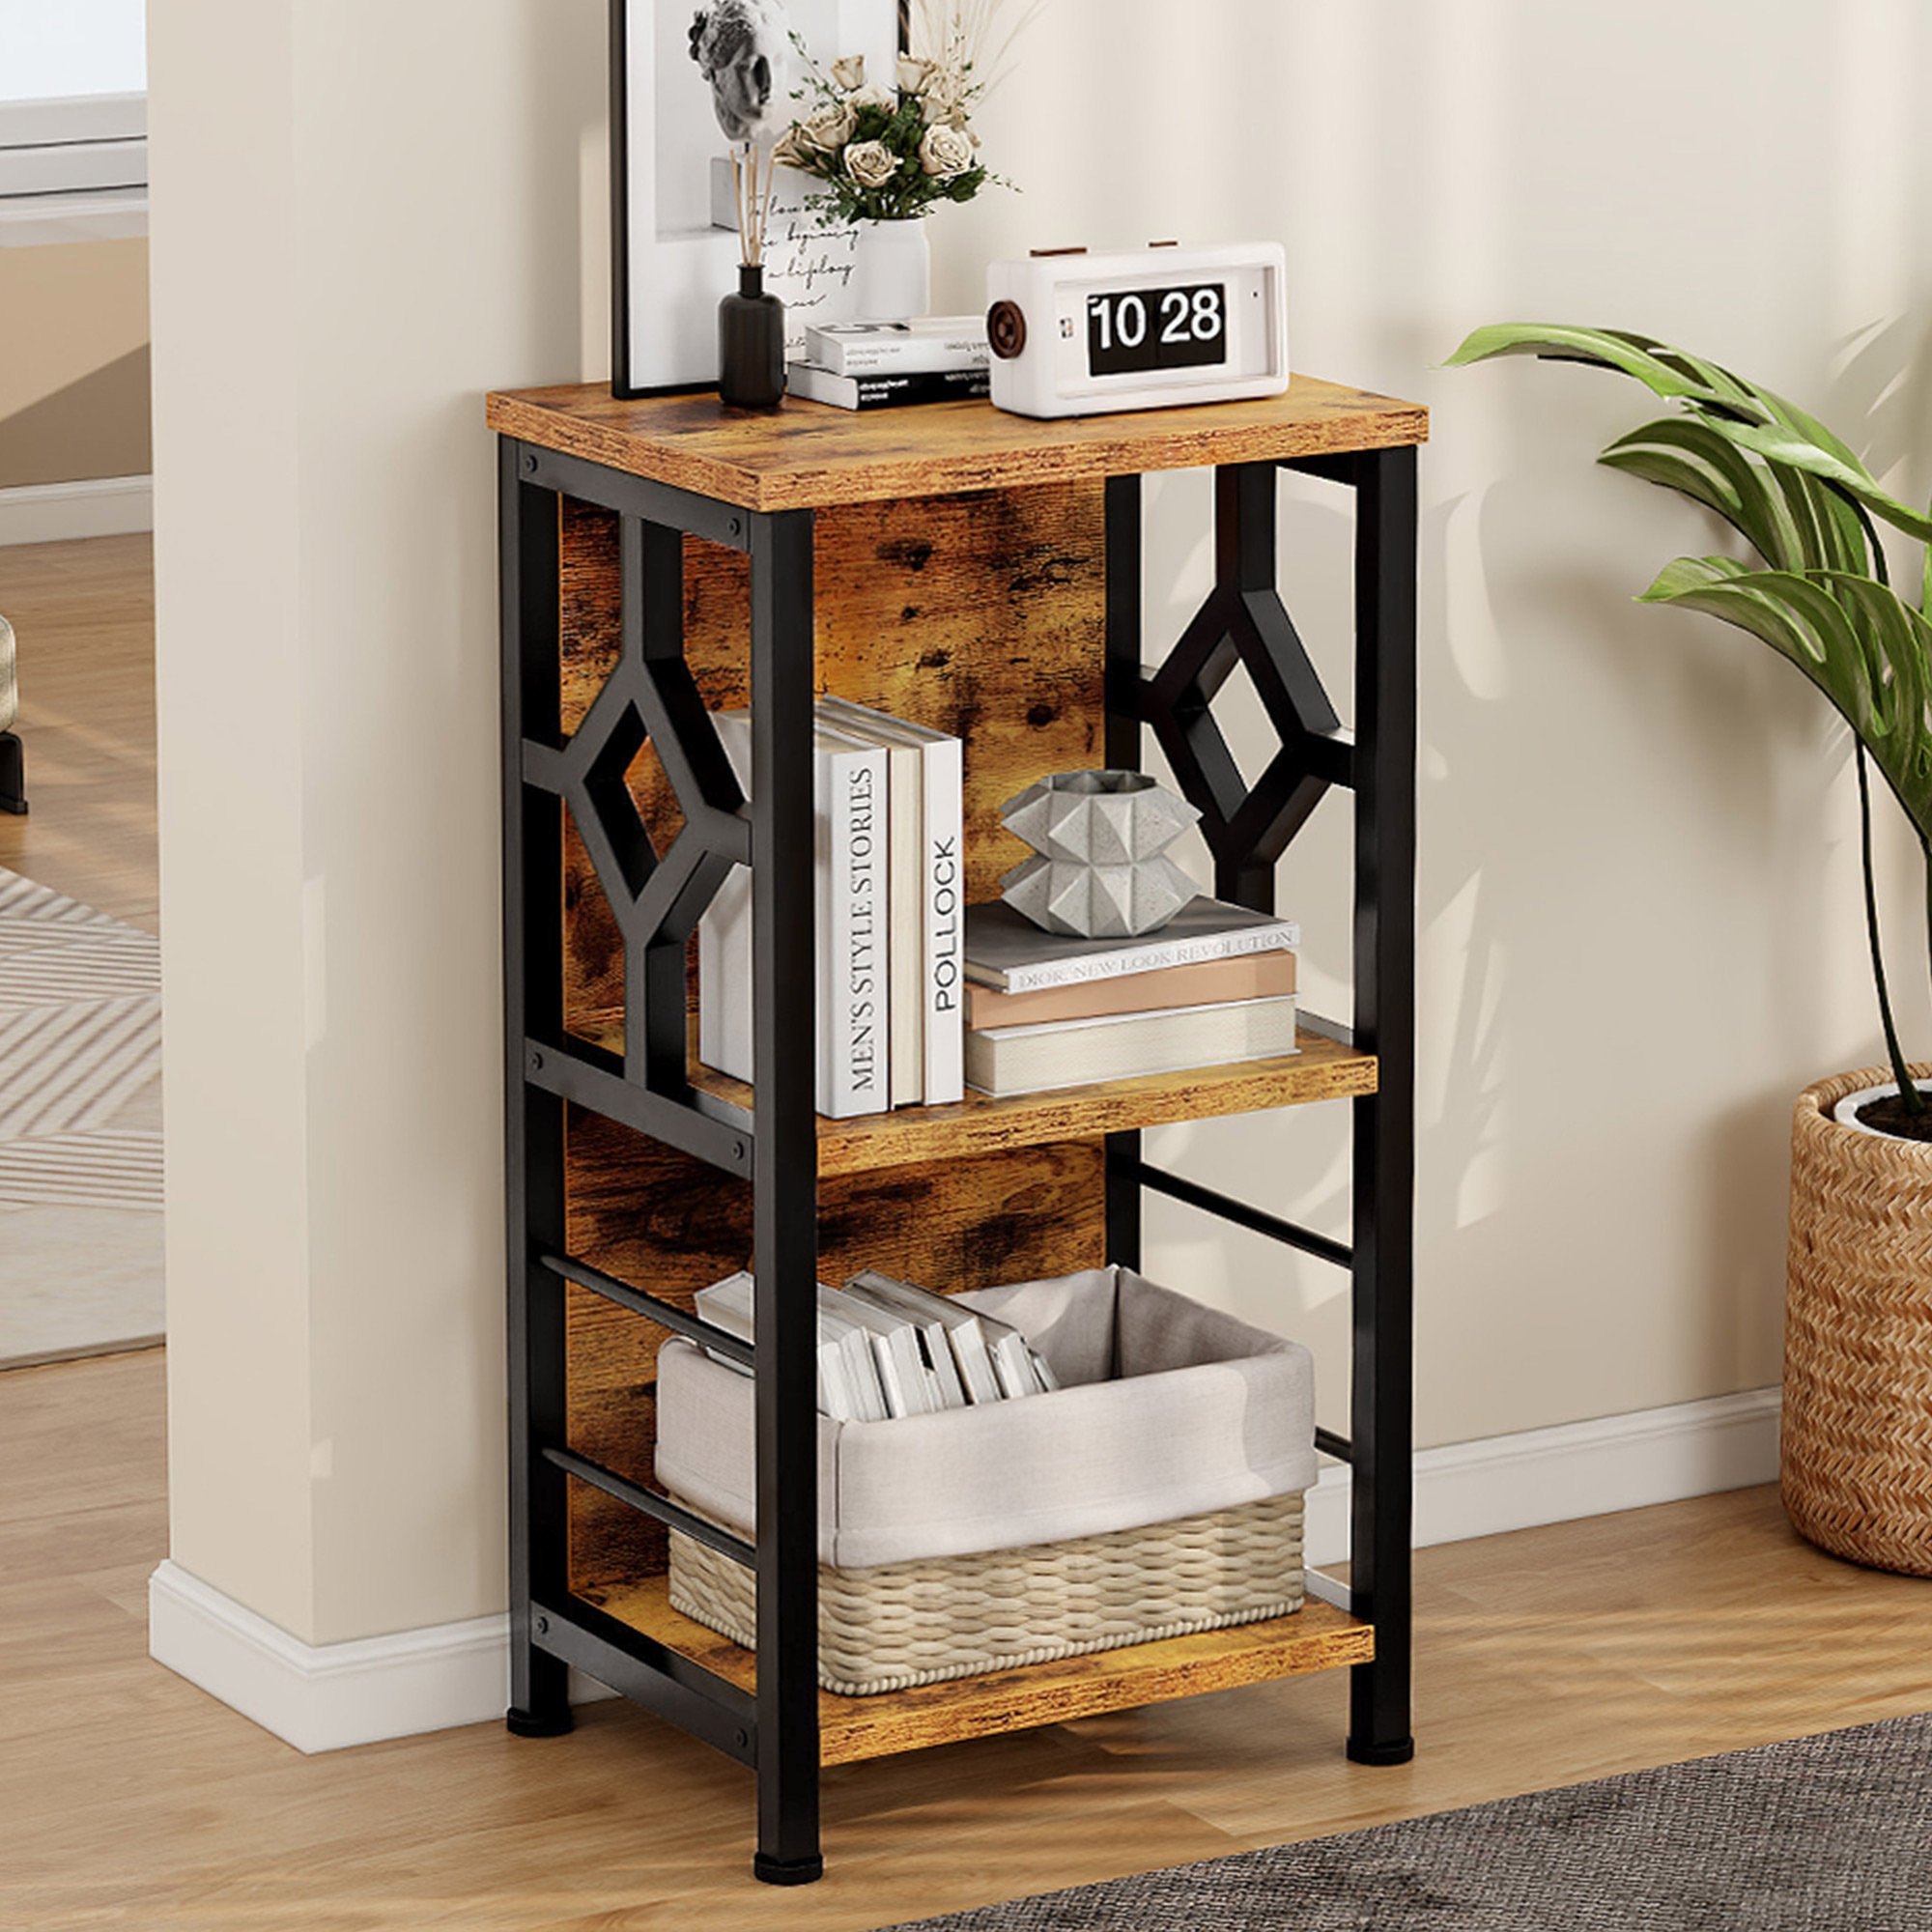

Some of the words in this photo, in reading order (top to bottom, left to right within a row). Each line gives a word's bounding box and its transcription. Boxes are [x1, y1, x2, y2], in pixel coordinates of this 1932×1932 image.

[1091, 295, 1147, 350] 10
[1160, 289, 1222, 343] 28
[849, 768, 872, 895] STORIES
[851, 900, 874, 992] STYLE
[934, 837, 957, 1011] POLLOCK
[1074, 961, 1118, 979] NEW
[1121, 952, 1172, 971] LOOK
[1177, 930, 1294, 963] REVOLUTION
[851, 1002, 875, 1092] MEN'S
